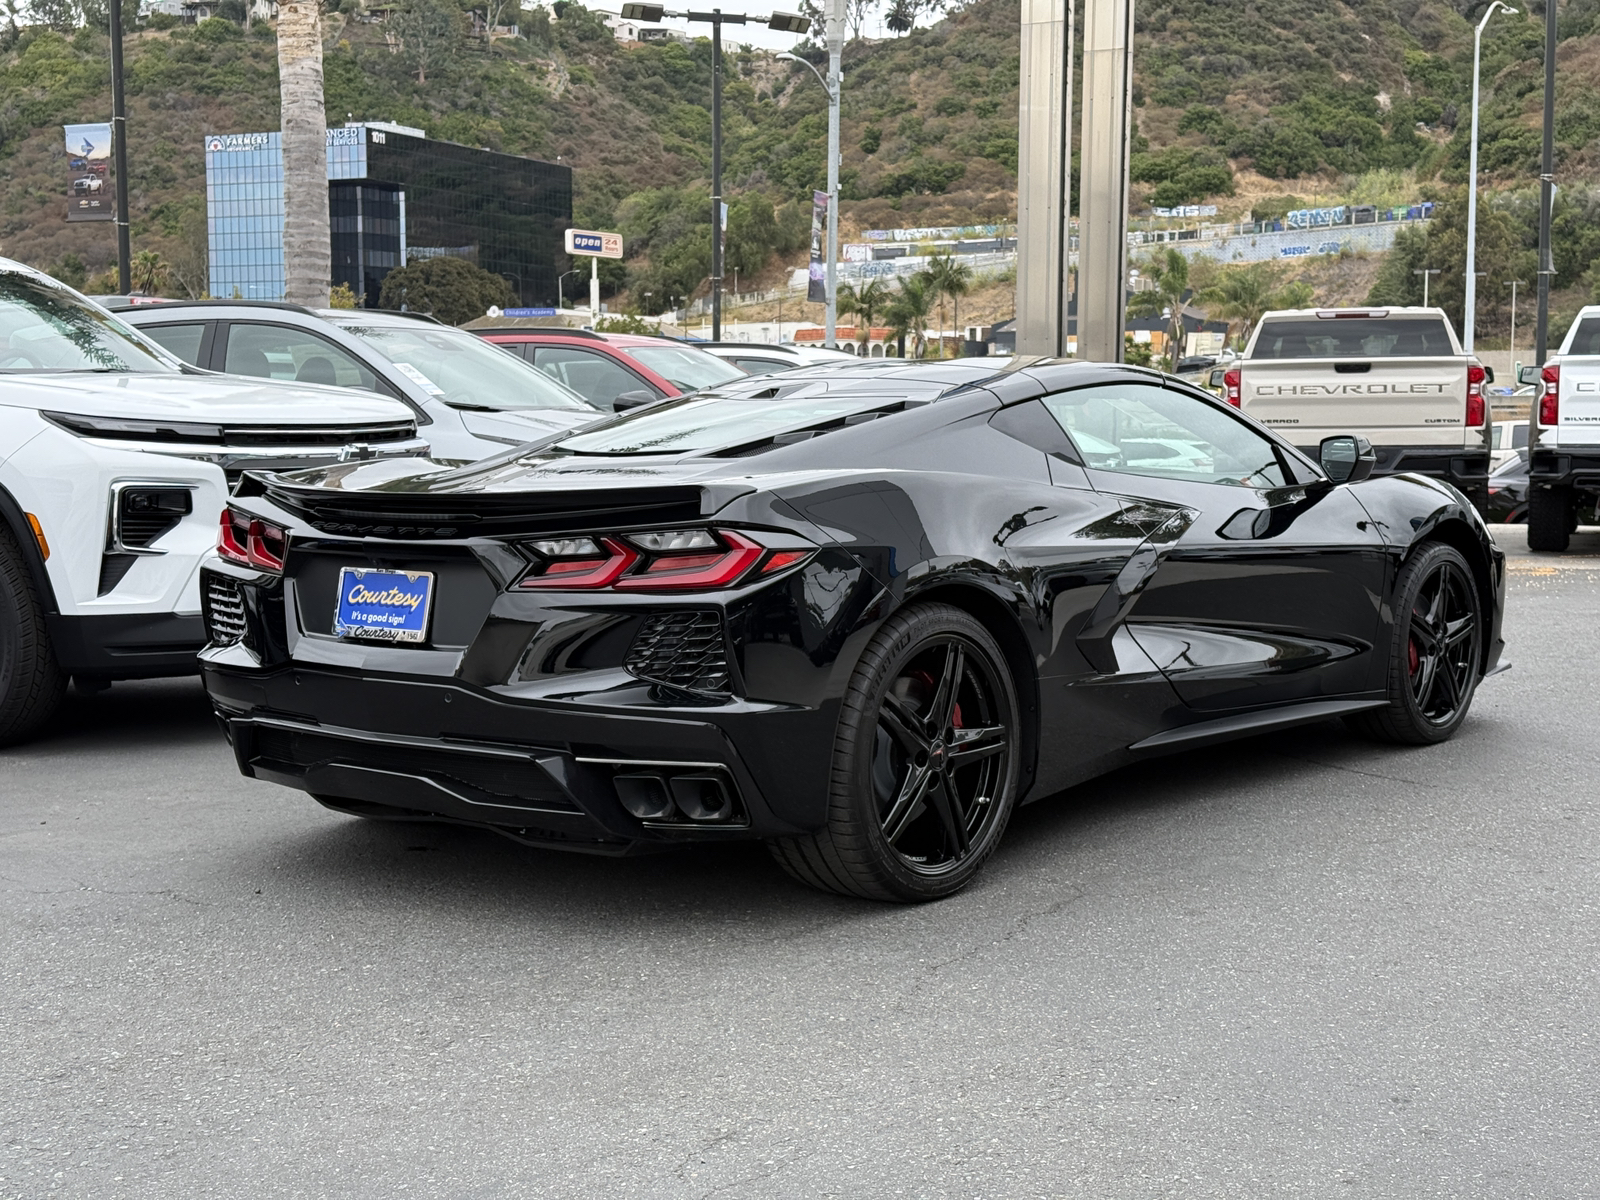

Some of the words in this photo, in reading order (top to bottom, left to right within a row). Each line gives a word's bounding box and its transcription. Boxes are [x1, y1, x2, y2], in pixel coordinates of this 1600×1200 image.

[227, 136, 268, 146] FARMERS
[371, 131, 386, 144] 1011
[575, 237, 601, 247] open
[1256, 383, 1450, 395] CHEVROLET
[310, 520, 458, 536] CORVETTE
[348, 584, 423, 611] Courtesy
[351, 611, 361, 620] It's
[367, 612, 388, 623] good
[388, 613, 405, 625] sign!
[355, 626, 399, 640] Courtesy
[867, 631, 911, 699] MICHELIN
